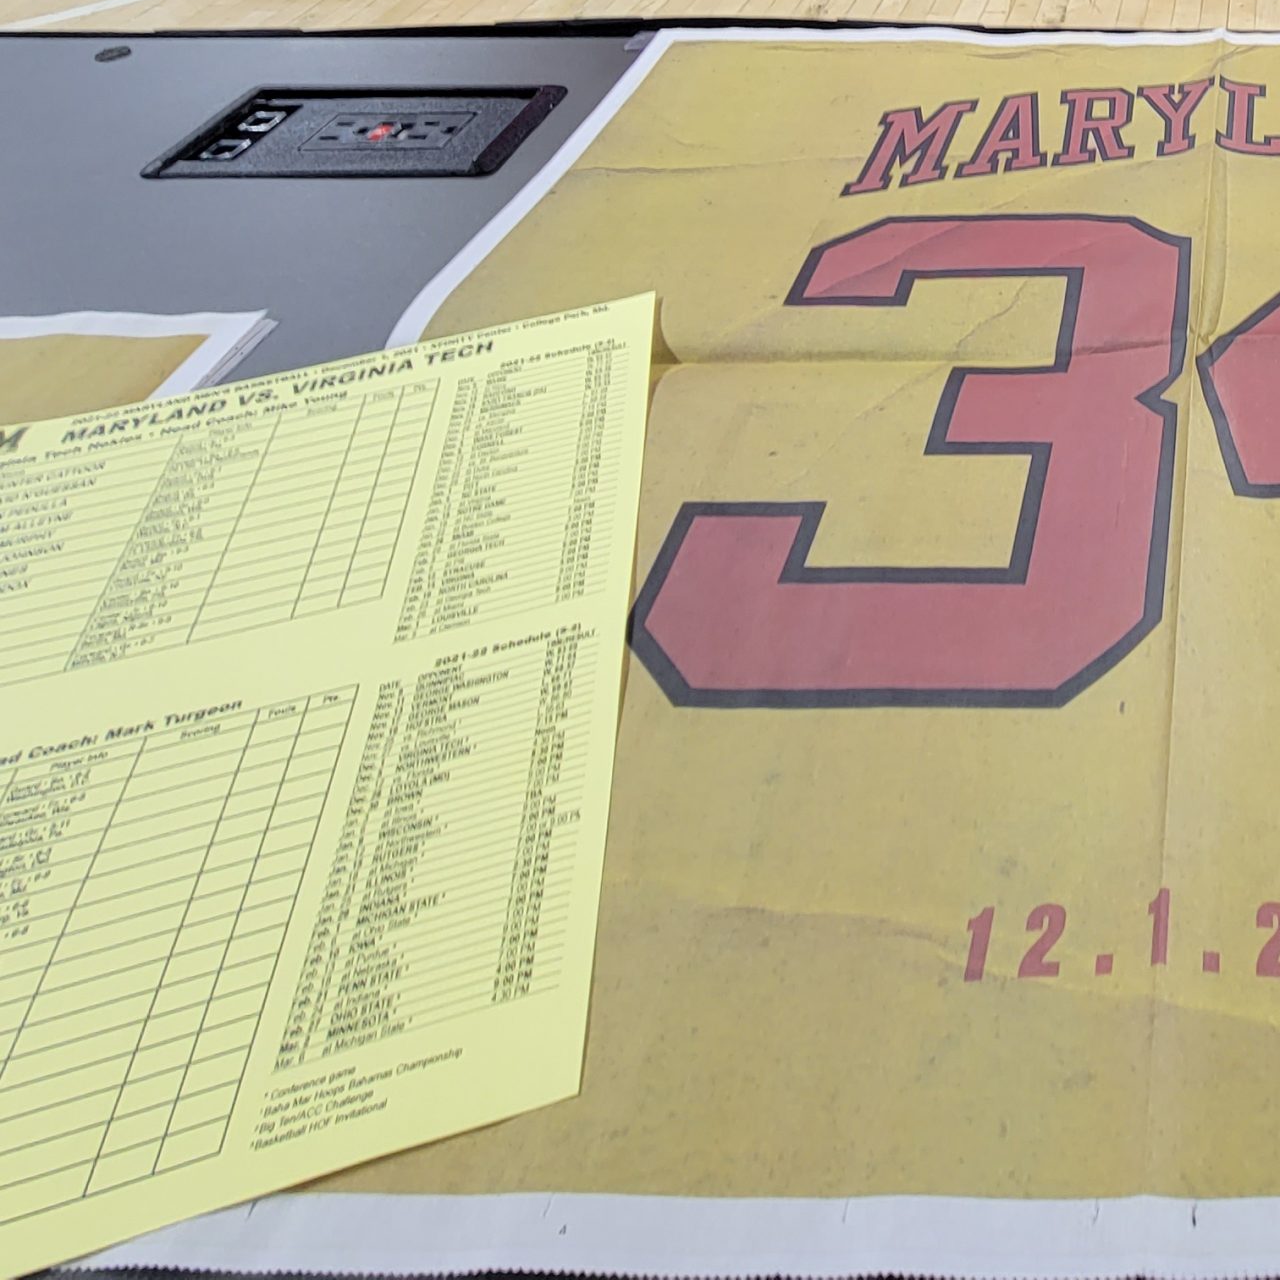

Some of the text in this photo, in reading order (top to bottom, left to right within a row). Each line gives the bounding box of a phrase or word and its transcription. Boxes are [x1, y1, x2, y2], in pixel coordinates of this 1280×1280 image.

[59, 338, 497, 444] MARYLAND VS. VIRGINIA TECH
[105, 718, 156, 743] Mark
[164, 698, 243, 727] Turgeon
